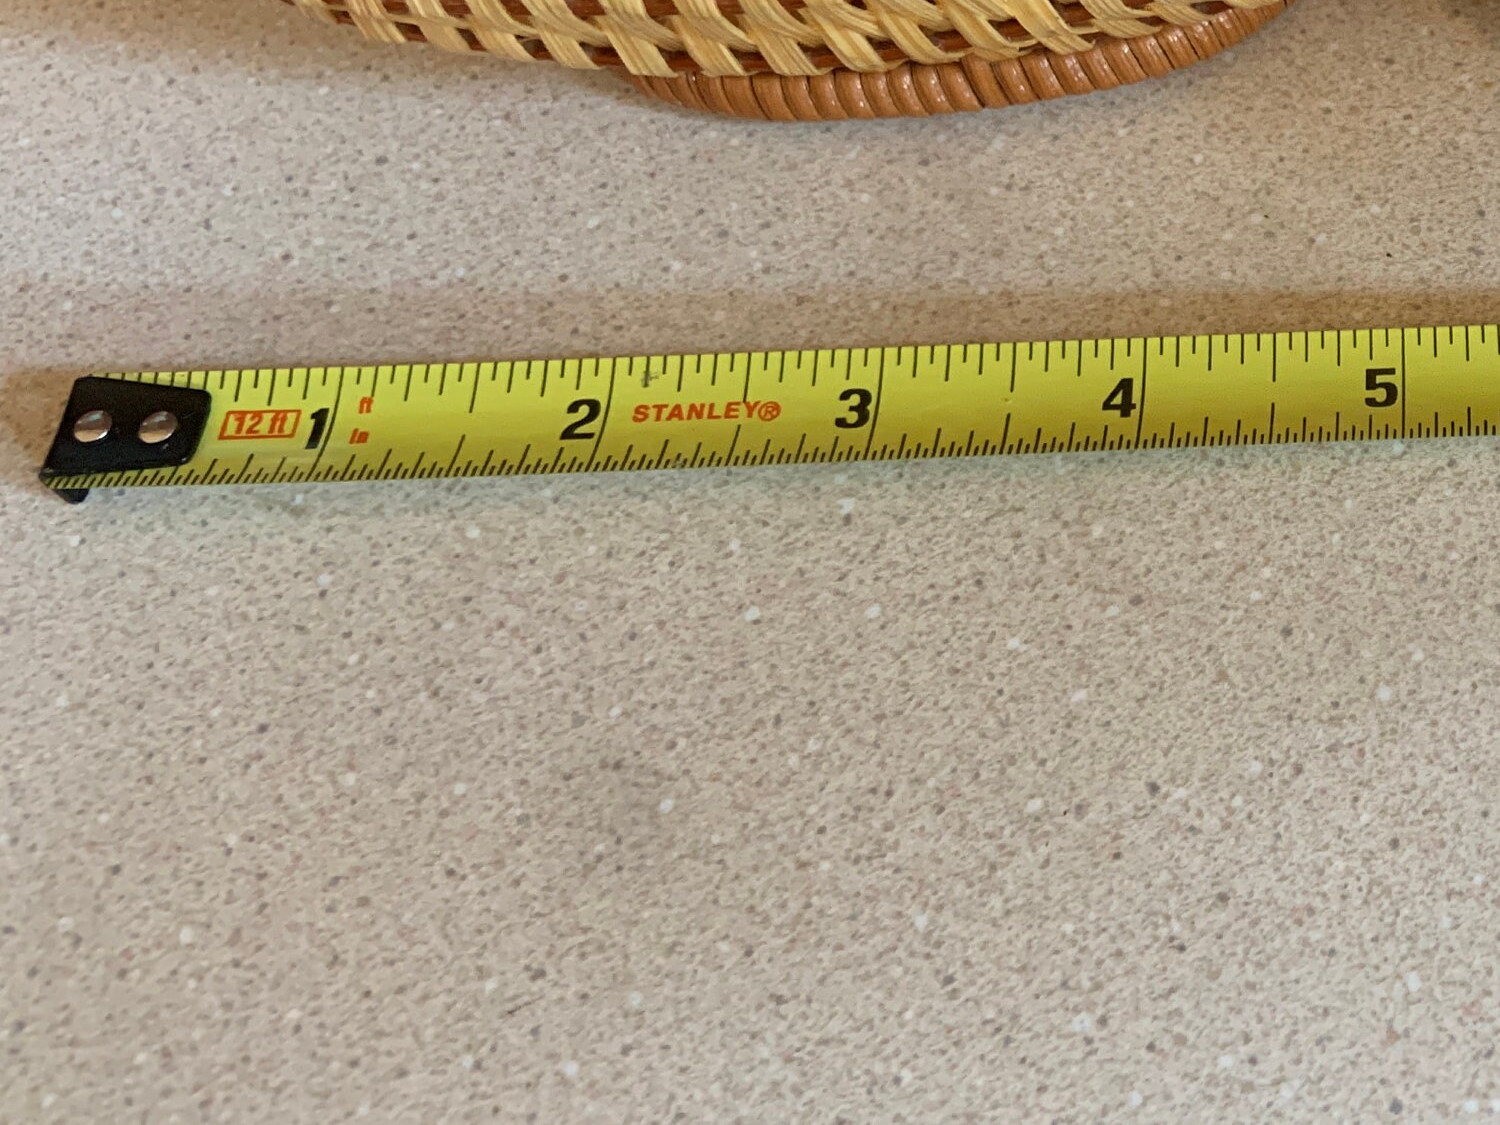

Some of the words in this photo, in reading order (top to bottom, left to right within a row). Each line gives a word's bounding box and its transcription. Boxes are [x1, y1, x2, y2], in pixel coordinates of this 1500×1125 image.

[358, 396, 375, 414] ft
[833, 388, 873, 429] 3
[1101, 377, 1137, 419] 4
[1364, 367, 1399, 409] 5
[233, 412, 263, 435] 12
[268, 411, 288, 434] ft
[305, 407, 330, 450] 1
[559, 398, 602, 441] 2
